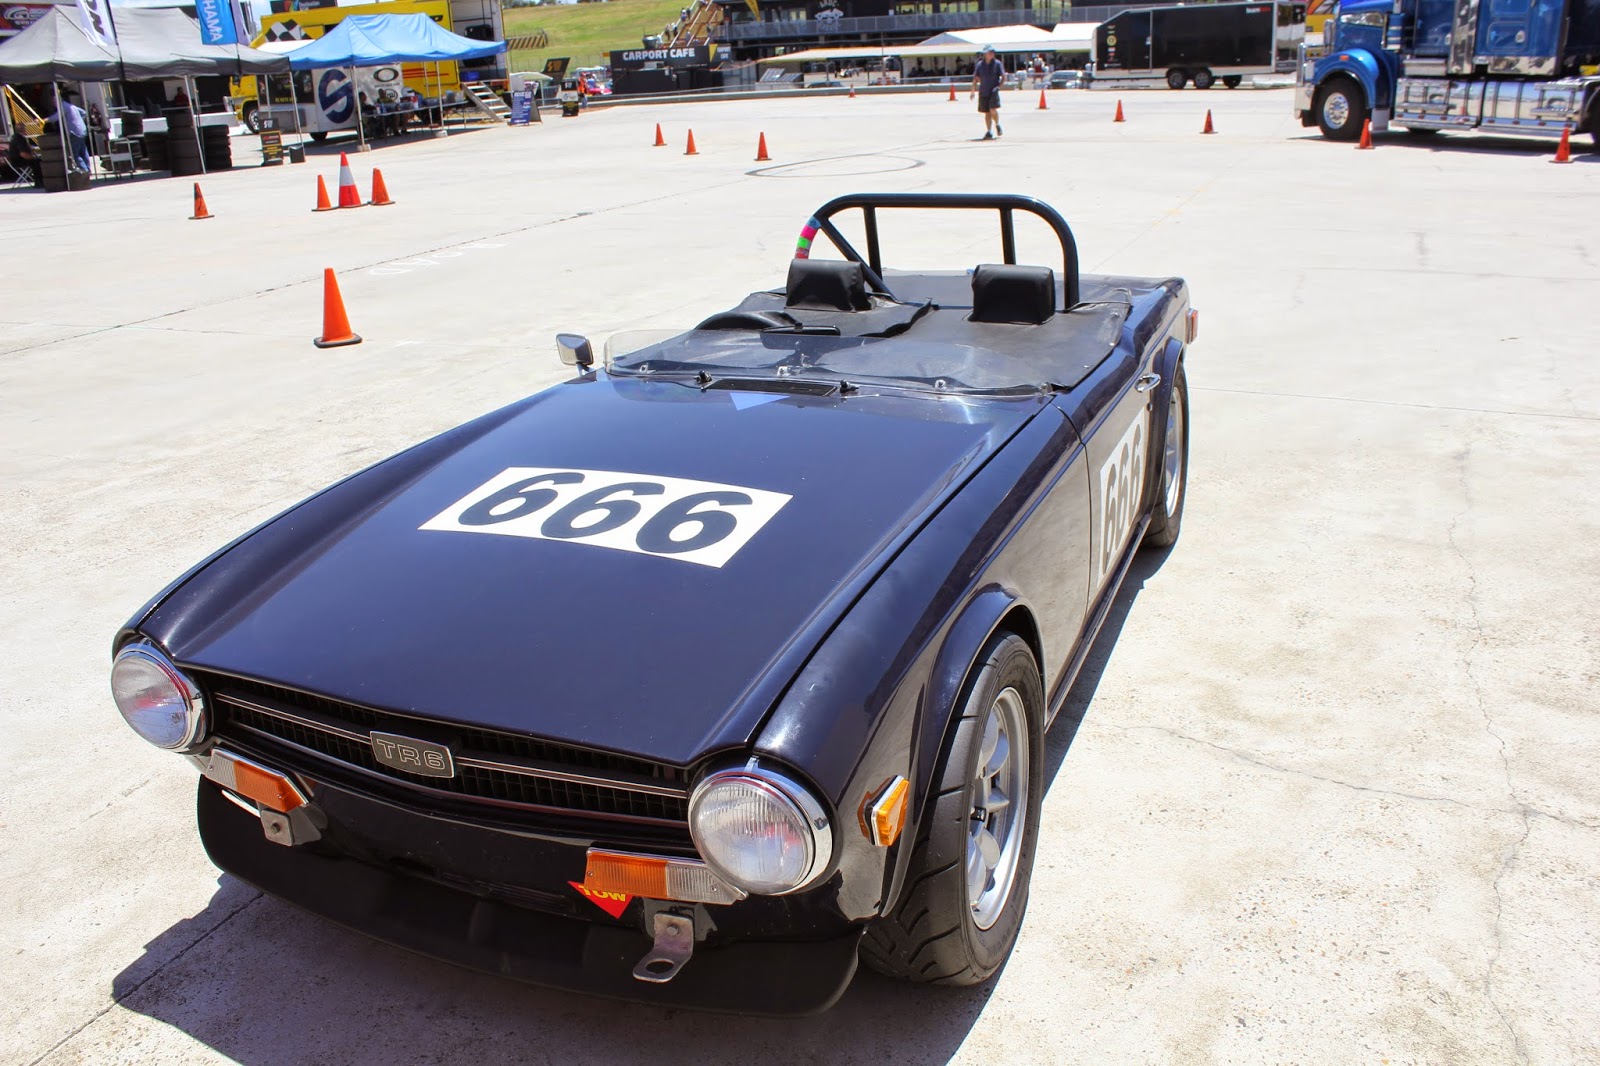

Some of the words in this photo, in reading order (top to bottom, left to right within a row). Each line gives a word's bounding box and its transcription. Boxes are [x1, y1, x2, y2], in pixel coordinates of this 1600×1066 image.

[622, 49, 668, 61] CARPORT
[670, 47, 695, 58] CAFE
[458, 471, 753, 554] 666
[1102, 422, 1141, 576] 666
[376, 738, 446, 770] TR6
